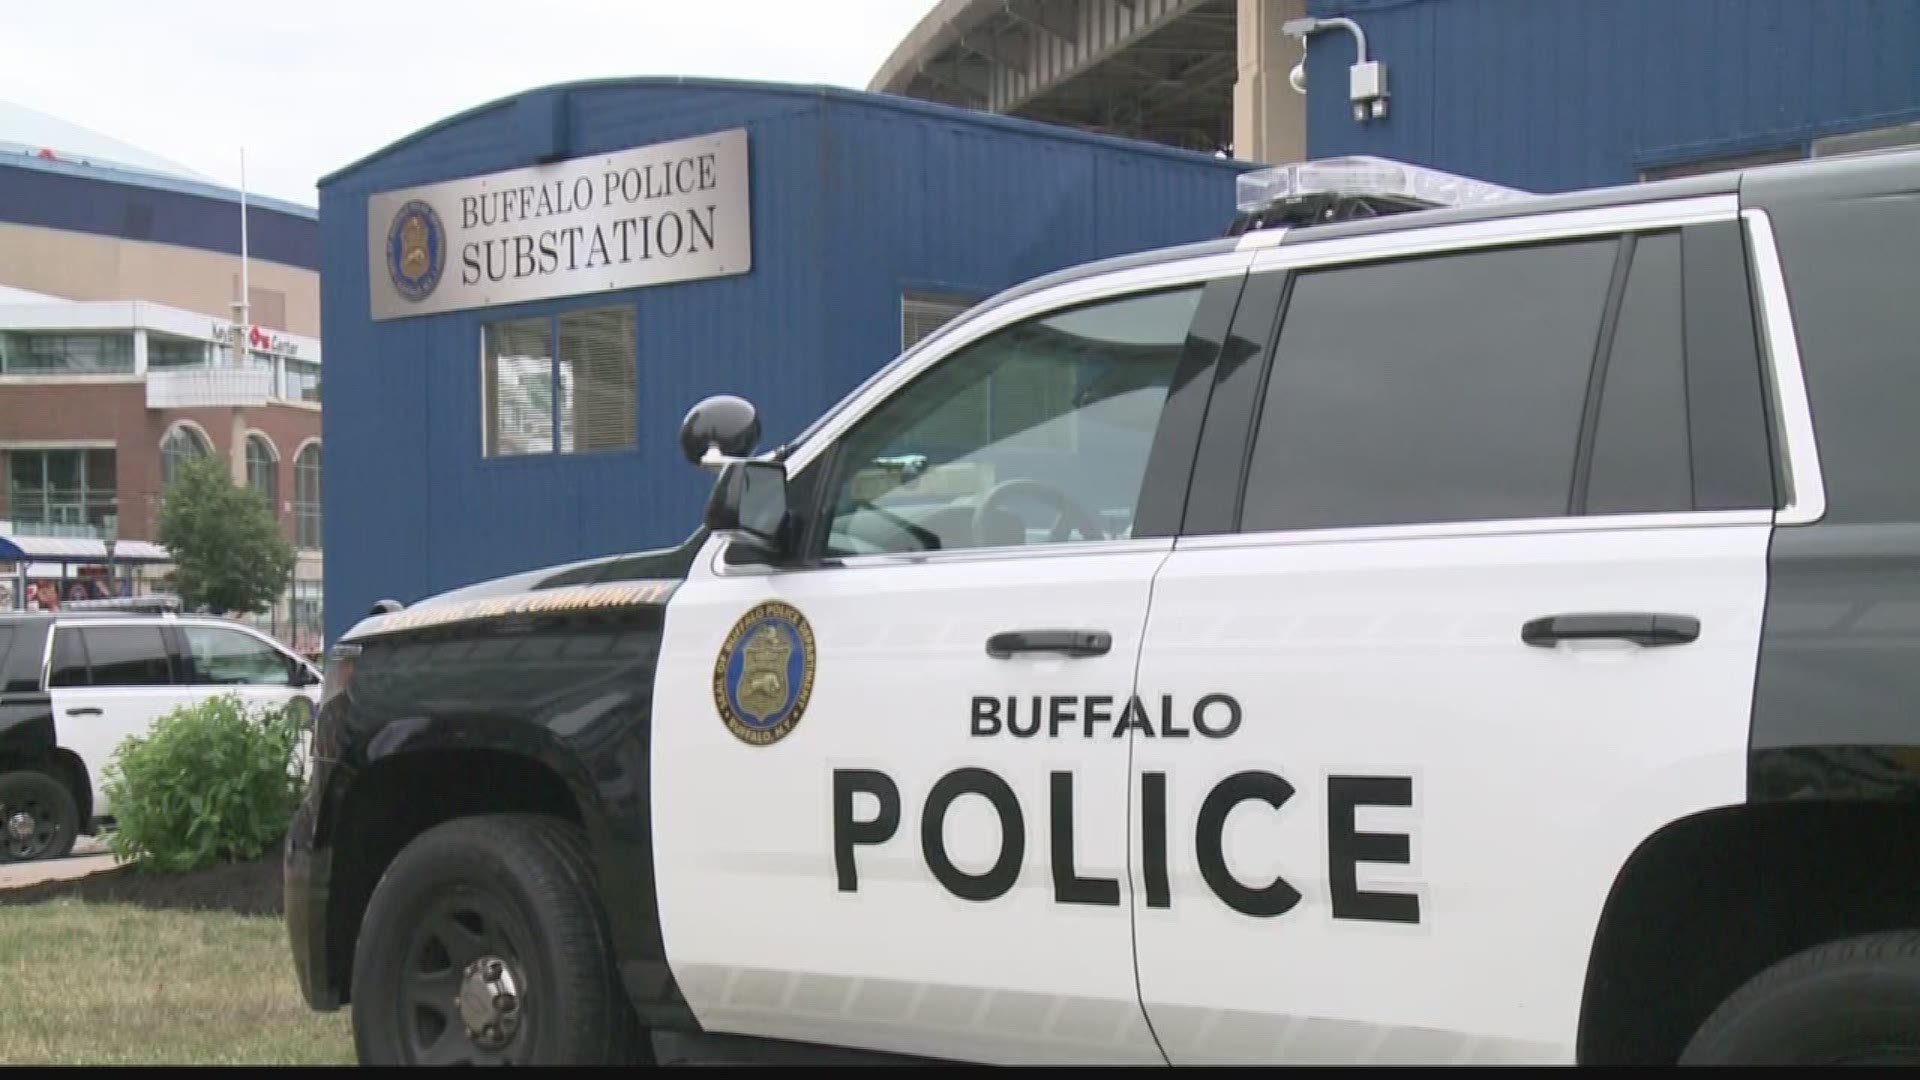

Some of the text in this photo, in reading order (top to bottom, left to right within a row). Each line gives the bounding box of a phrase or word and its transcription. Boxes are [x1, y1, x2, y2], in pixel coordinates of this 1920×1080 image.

[462, 153, 717, 229] BUFFALO POLICE
[462, 204, 717, 286] SUBSTATION
[515, 582, 668, 613] COMMUNITY
[766, 603, 800, 626] POLICE
[970, 693, 1242, 738] BUFFALO
[832, 766, 1421, 924] POLICE
